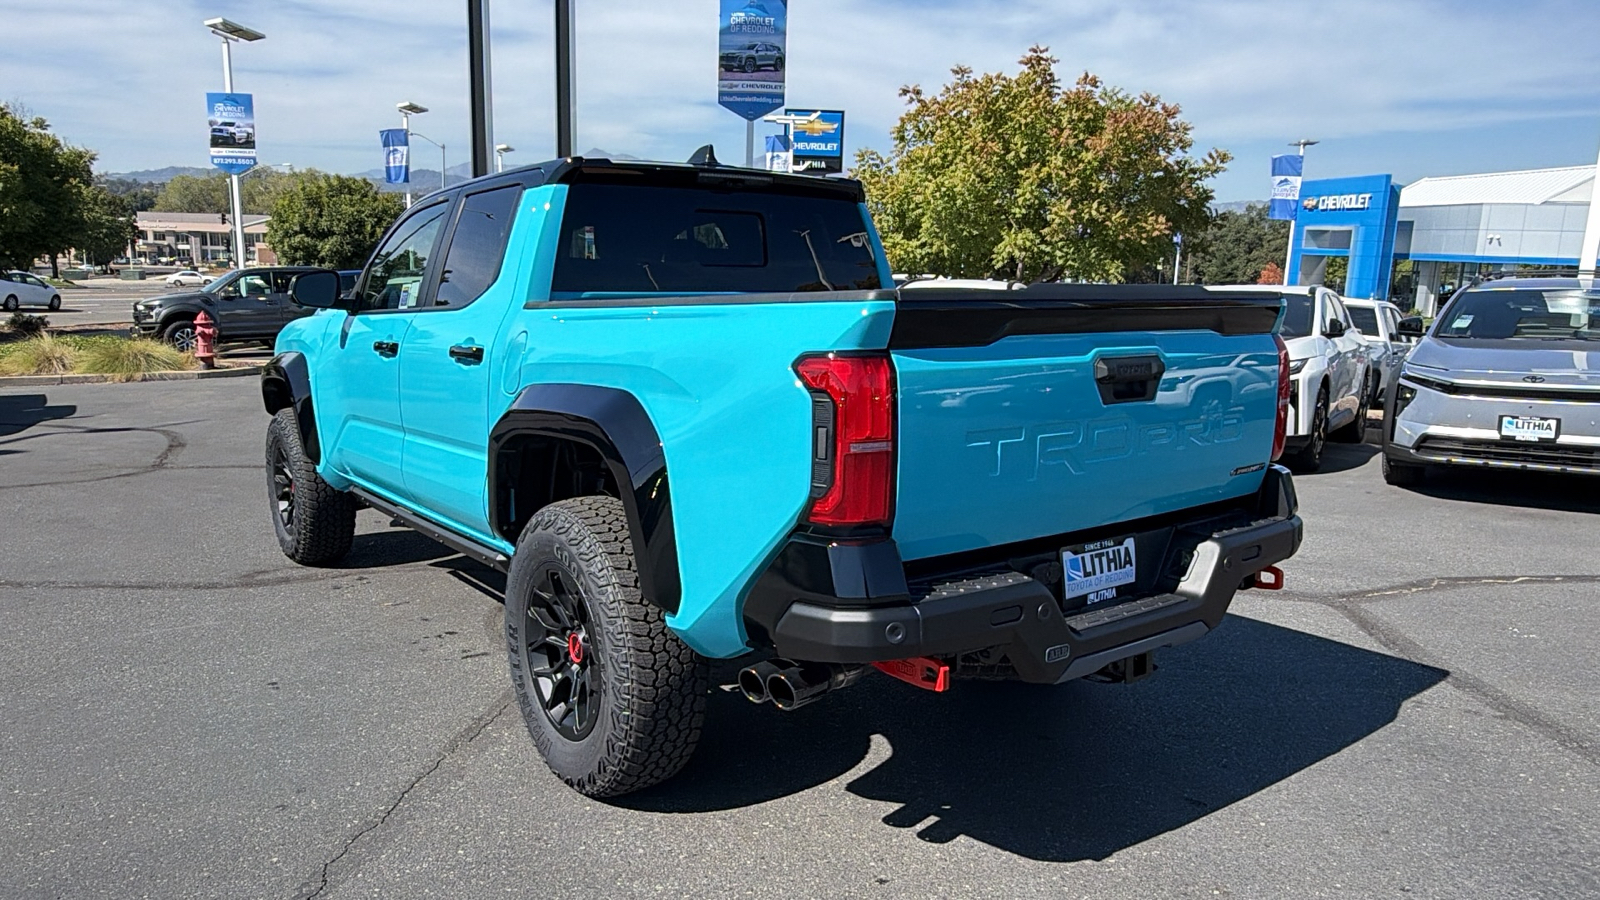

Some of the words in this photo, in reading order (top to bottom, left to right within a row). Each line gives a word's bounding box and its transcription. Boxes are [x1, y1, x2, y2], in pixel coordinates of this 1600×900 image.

[730, 16, 775, 26] CHEVROLET
[731, 25, 740, 33] OF
[741, 25, 775, 34] REDDING
[741, 82, 783, 90] CHEVROLET
[214, 105, 245, 113] CHEVROLET
[1319, 193, 1372, 210] CHEVROLET
[1515, 420, 1553, 431] LITHIA
[966, 416, 1132, 482] TRD
[1138, 412, 1245, 453] PRO
[1084, 542, 1101, 551] SINCE
[1102, 539, 1114, 548] 1946
[1080, 546, 1133, 579] LITHIA
[1067, 579, 1094, 593] TOYOTA
[1095, 576, 1104, 587] OF
[1105, 568, 1134, 584] REDDING
[1095, 587, 1117, 602] LITHIA
[1048, 646, 1068, 661] ARB
[508, 623, 553, 756] WRANGLER
